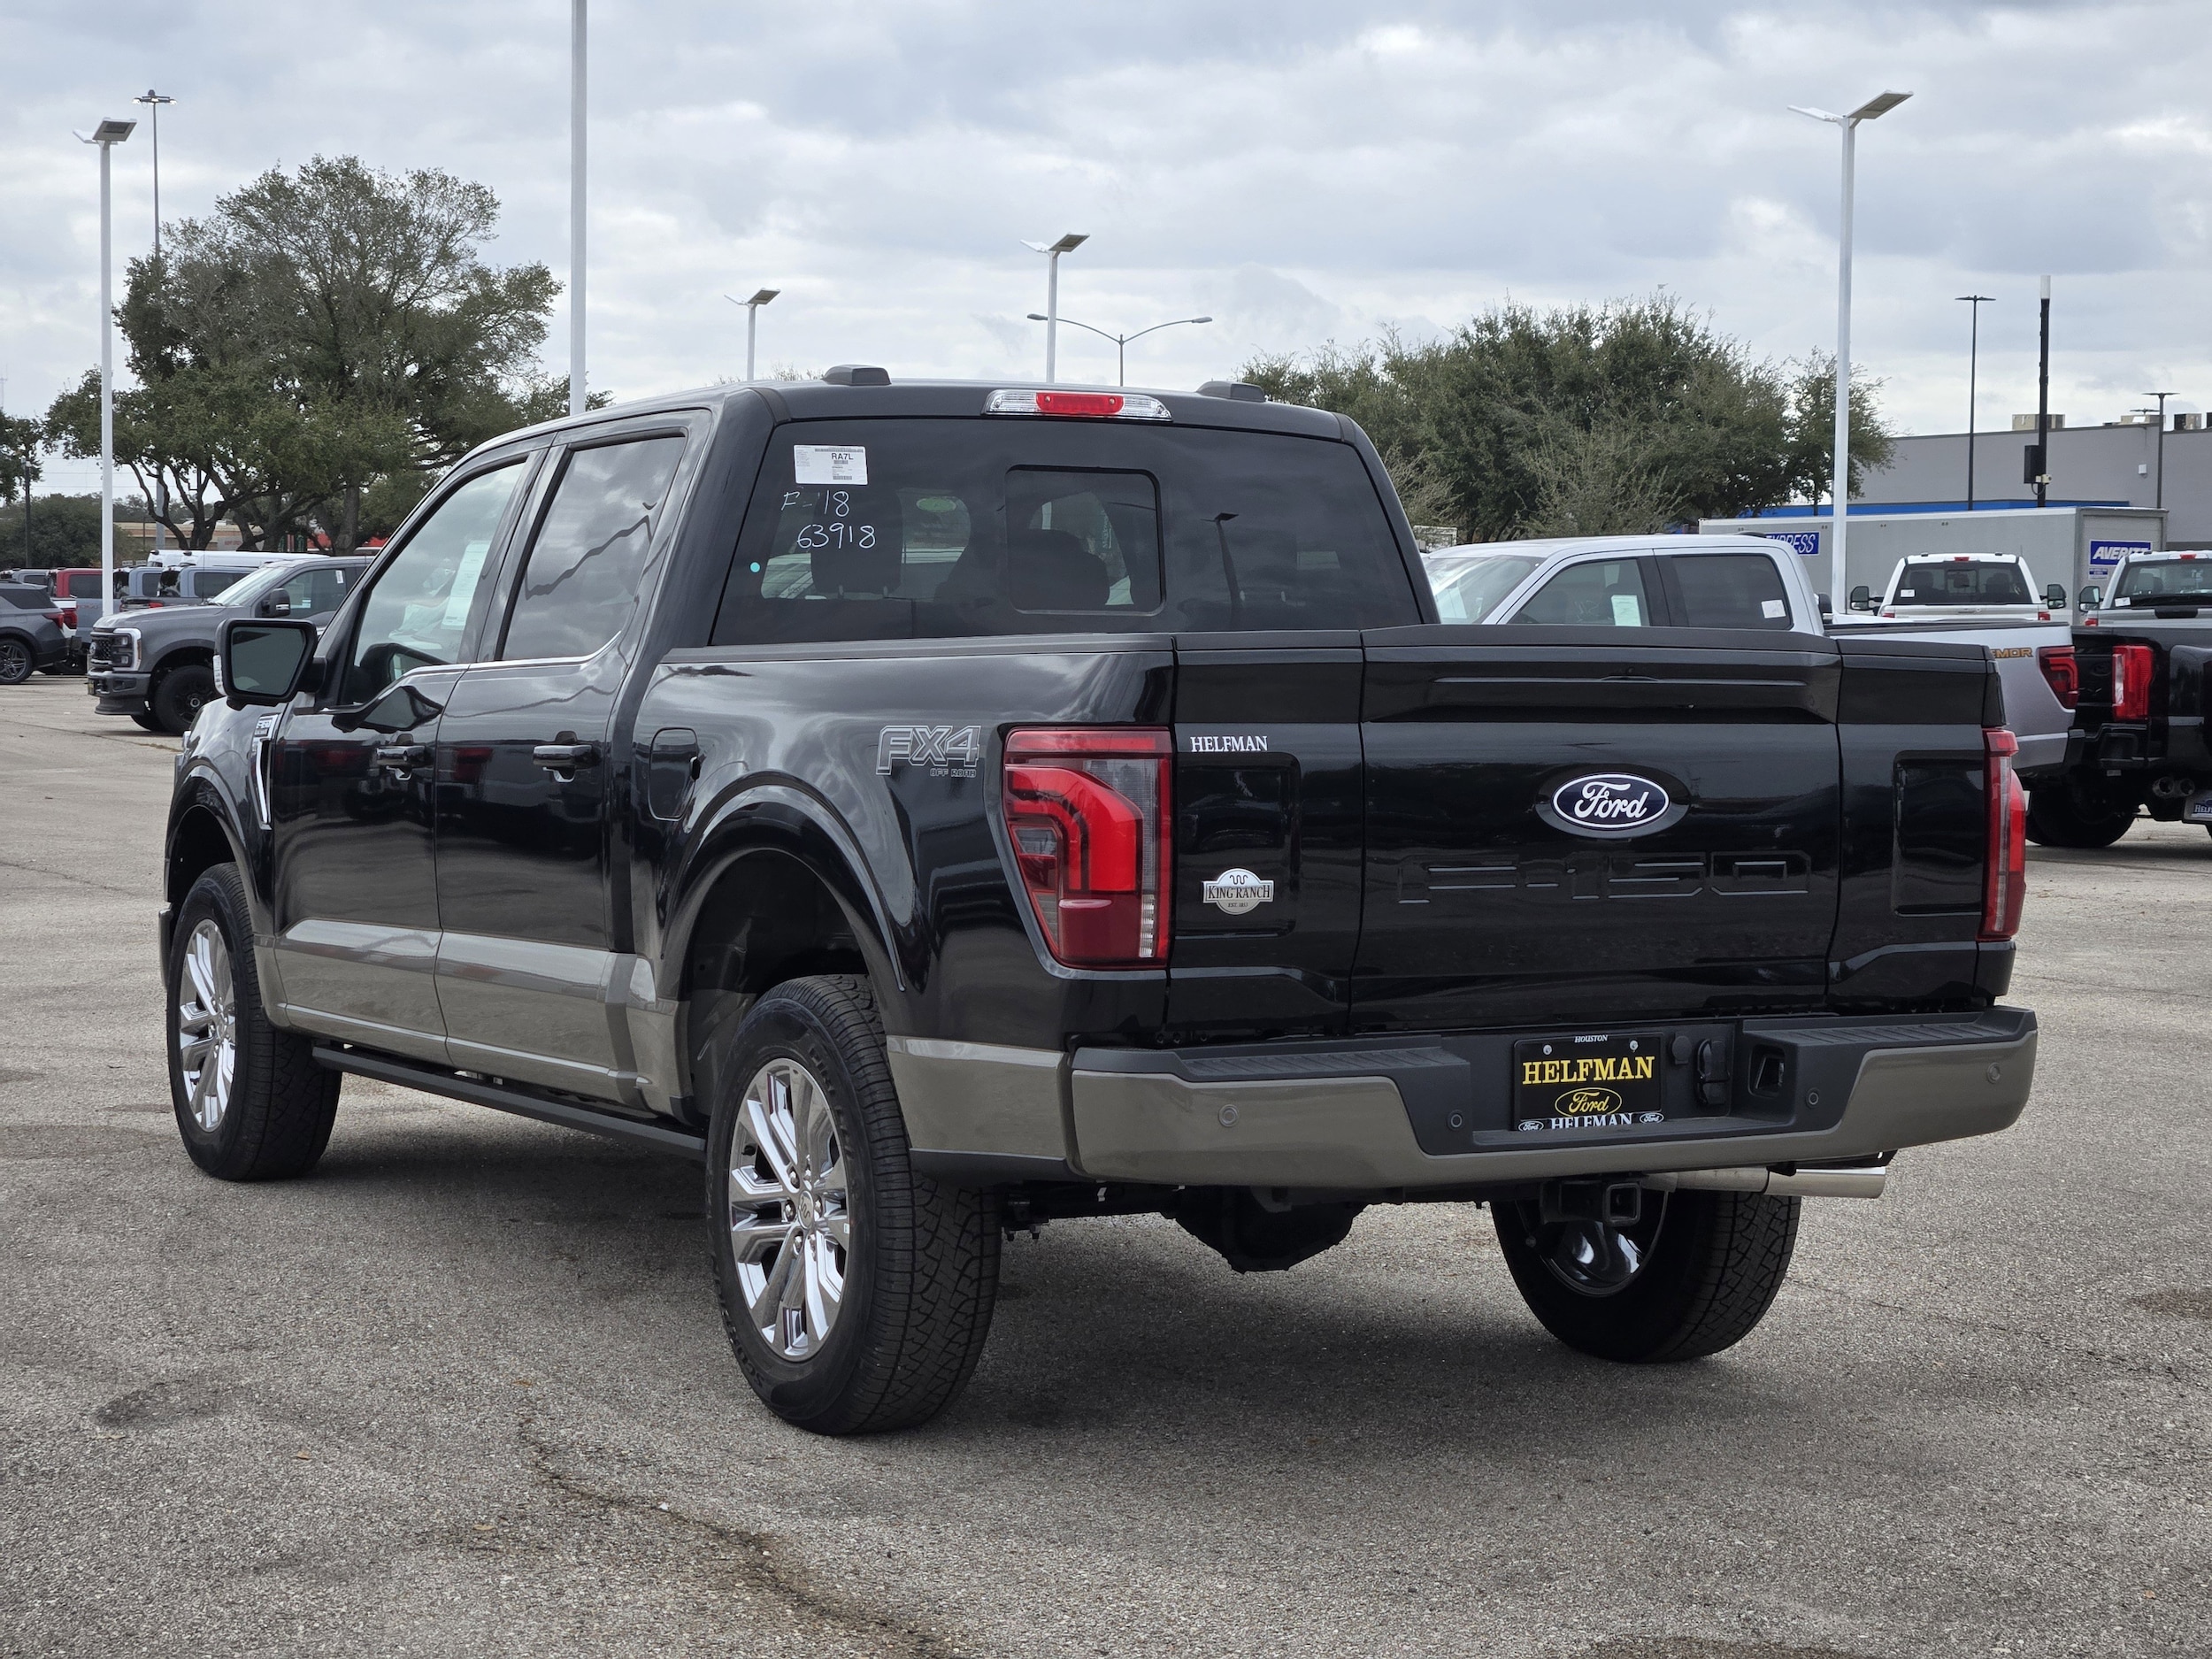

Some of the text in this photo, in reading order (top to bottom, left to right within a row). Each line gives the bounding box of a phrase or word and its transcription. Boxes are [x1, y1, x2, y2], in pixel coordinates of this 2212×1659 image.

[796, 522, 876, 549] 63918
[1765, 534, 1816, 554] RESS
[876, 725, 982, 775] FX4
[1190, 735, 1268, 753] HELFMAN
[929, 768, 977, 778] OFF ROAD
[1574, 781, 1650, 818] Ford
[1208, 885, 1271, 899] KING RANCH
[1574, 1034, 1609, 1043] HOUSTON
[1522, 1056, 1655, 1085] HELFMAN
[1569, 1091, 1609, 1113] Ford
[1523, 1122, 1540, 1131] Ford
[1643, 1113, 1660, 1123] Ford
